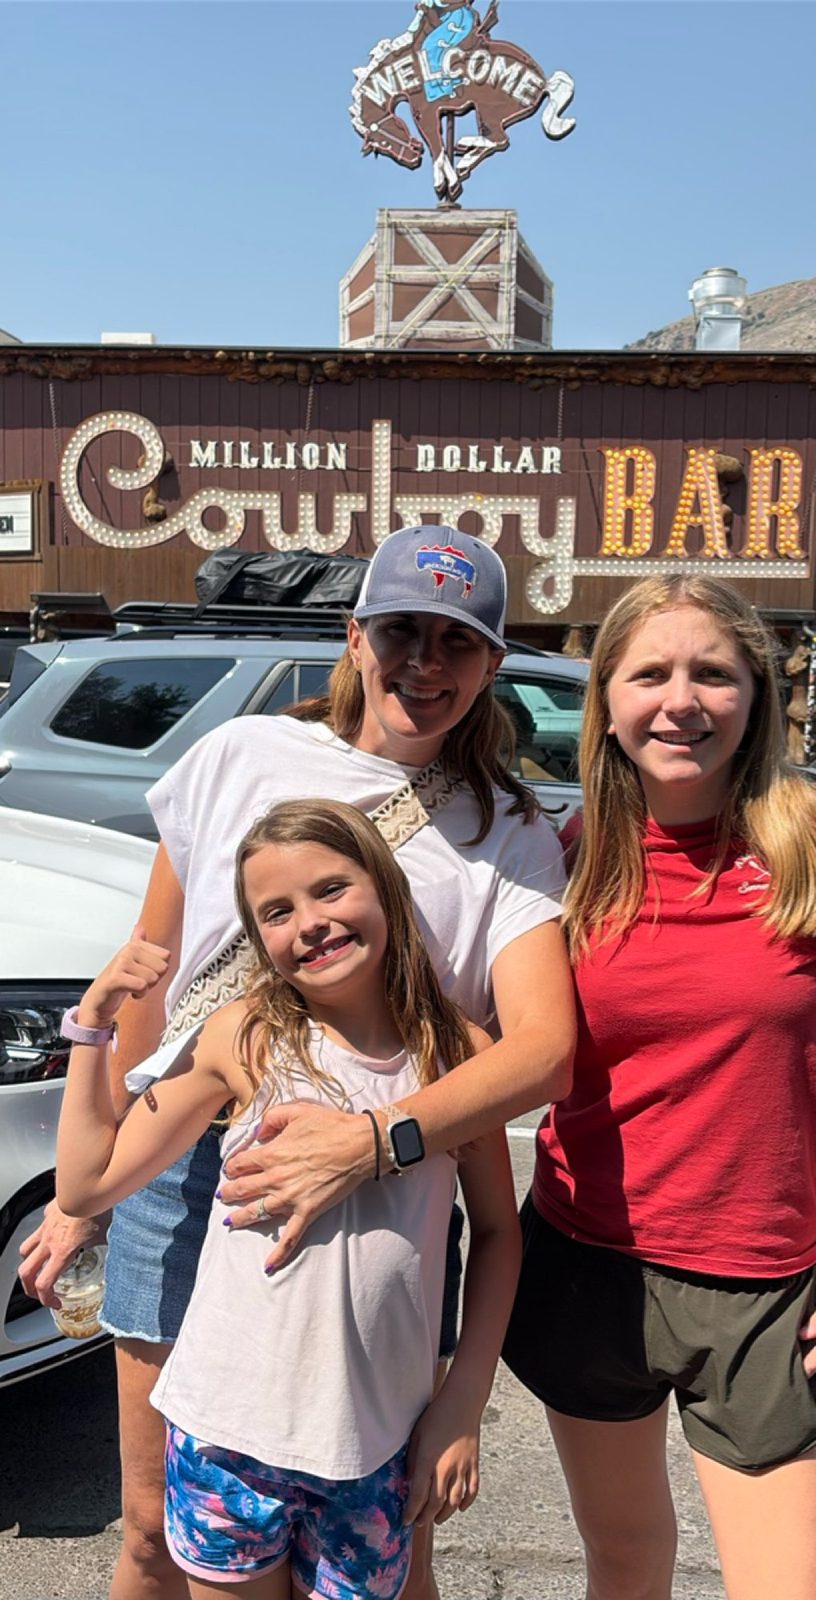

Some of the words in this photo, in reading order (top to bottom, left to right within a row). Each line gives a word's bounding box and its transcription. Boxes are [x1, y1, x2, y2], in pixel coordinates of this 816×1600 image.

[362, 48, 543, 106] WELCOME
[189, 440, 348, 470] MILLION
[415, 444, 562, 474] DOLLAR
[60, 411, 577, 614] Cowboy
[600, 446, 808, 559] BAR
